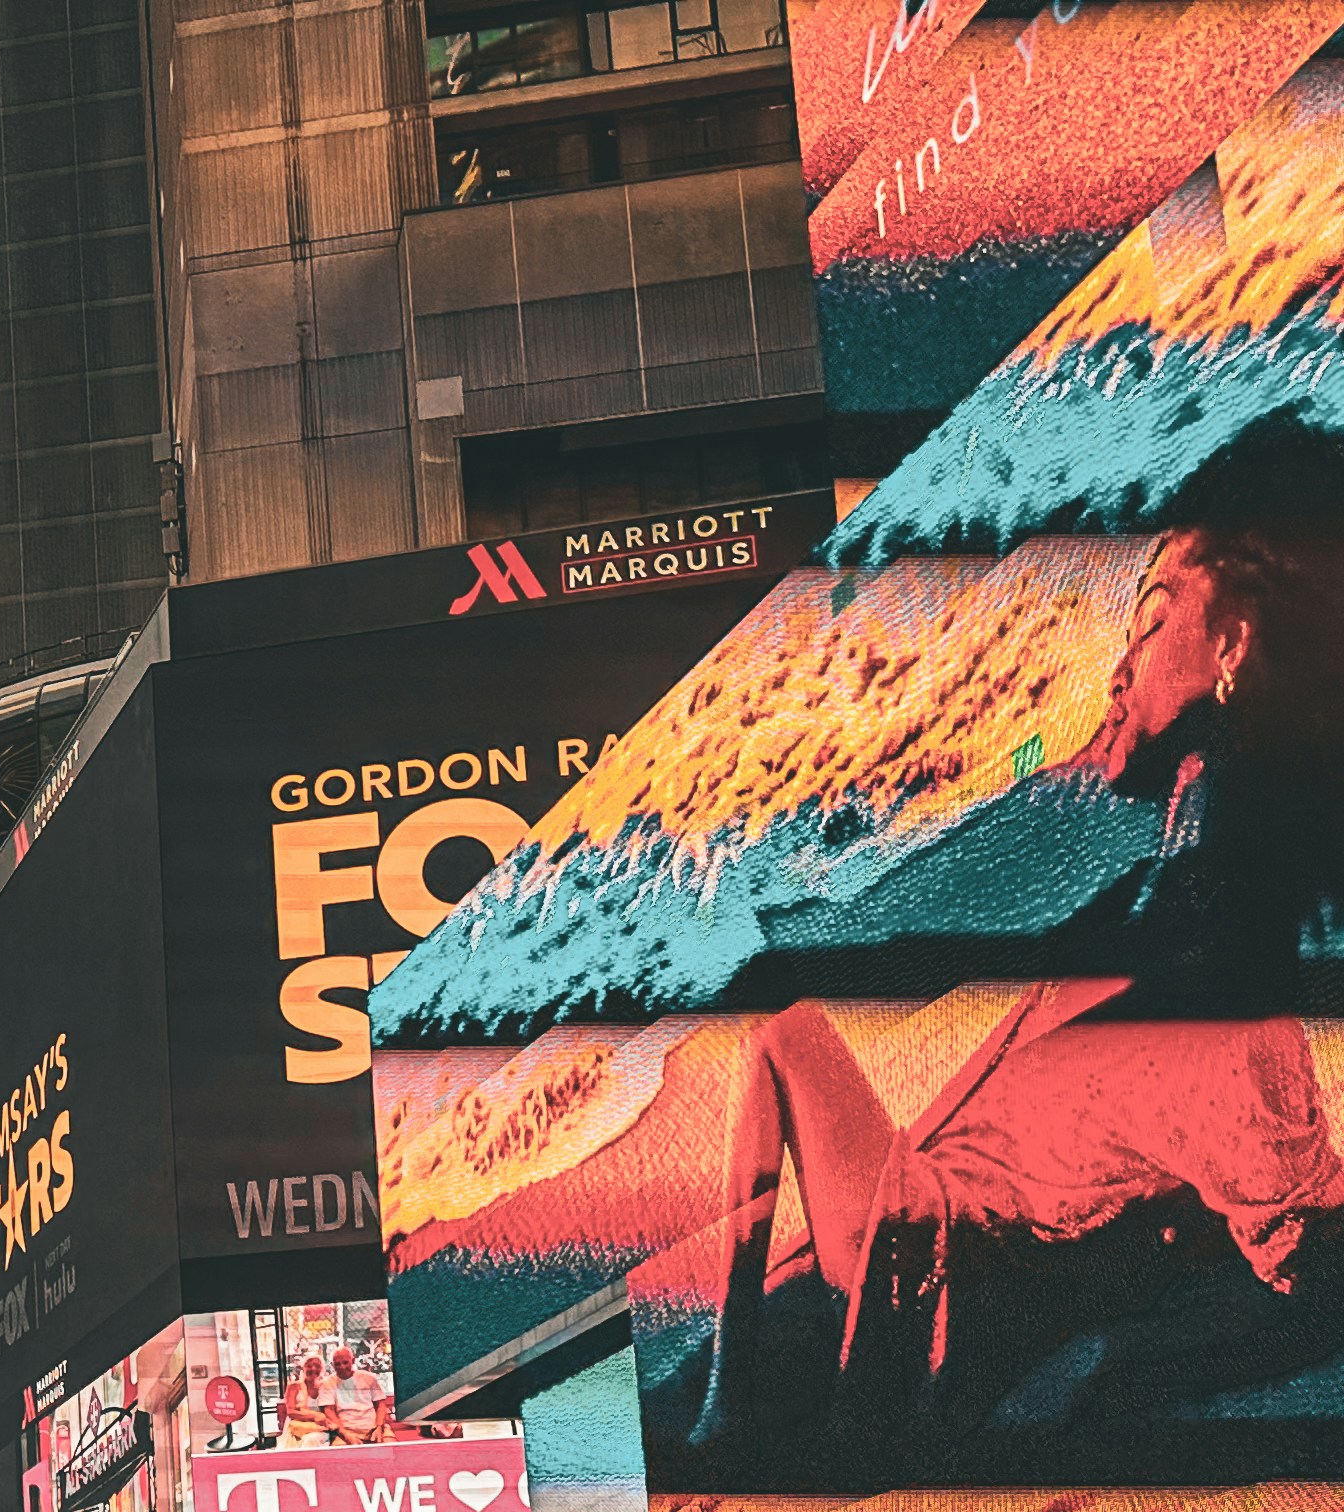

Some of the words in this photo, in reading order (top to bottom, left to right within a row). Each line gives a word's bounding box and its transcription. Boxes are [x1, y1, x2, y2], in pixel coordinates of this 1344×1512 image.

[874, 73, 982, 238] find
[564, 507, 773, 557] MARRIOTT
[567, 542, 752, 590] MARQUIS
[271, 744, 528, 812] GORDON
[43, 1263, 77, 1315] hulu
[36, 1360, 68, 1395] MARRIOTT
[37, 1381, 66, 1412] MARQUIS
